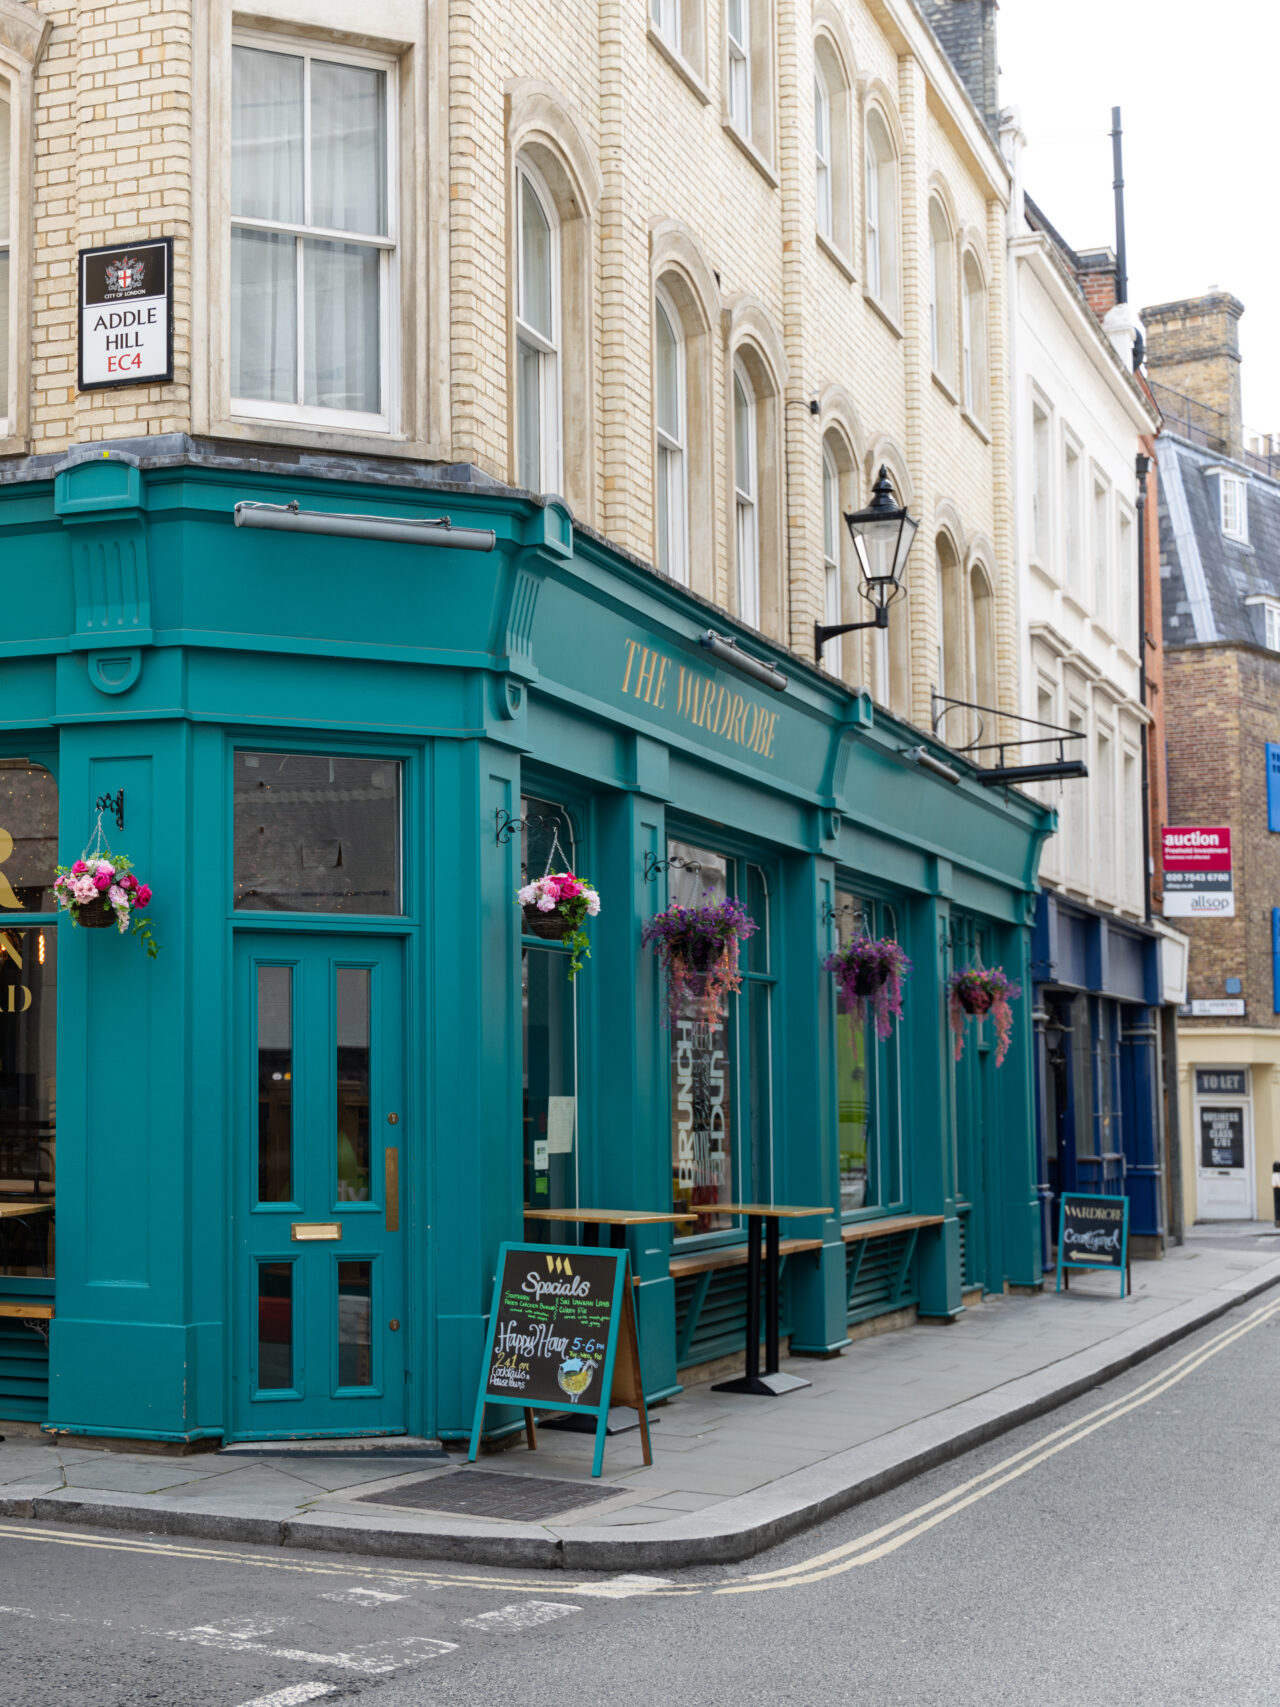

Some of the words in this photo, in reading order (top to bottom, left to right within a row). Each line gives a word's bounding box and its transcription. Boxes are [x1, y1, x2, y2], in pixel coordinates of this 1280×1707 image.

[124, 289, 146, 297] LONDON
[93, 307, 157, 332] ADDLE
[105, 331, 144, 351] HILL
[107, 353, 143, 373] EC4
[621, 637, 672, 710] THE
[676, 665, 781, 760] WARDROBE
[1164, 830, 1220, 846] auction
[1166, 873, 1183, 881] 020
[1191, 895, 1229, 911] allsop
[1201, 1074, 1218, 1089] TO
[1220, 1074, 1240, 1089] LET
[676, 1019, 695, 1189] BRUNCH
[1202, 1112, 1239, 1122] BUSINESS
[1209, 1129, 1234, 1139] CLASS
[1064, 1204, 1124, 1221] WARDROBE
[1064, 1228, 1121, 1251] Courtyard
[521, 1271, 591, 1302] Specials
[495, 1320, 540, 1358] Happy
[538, 1323, 570, 1360] Hour
[491, 1365, 525, 1379] Cocktails
